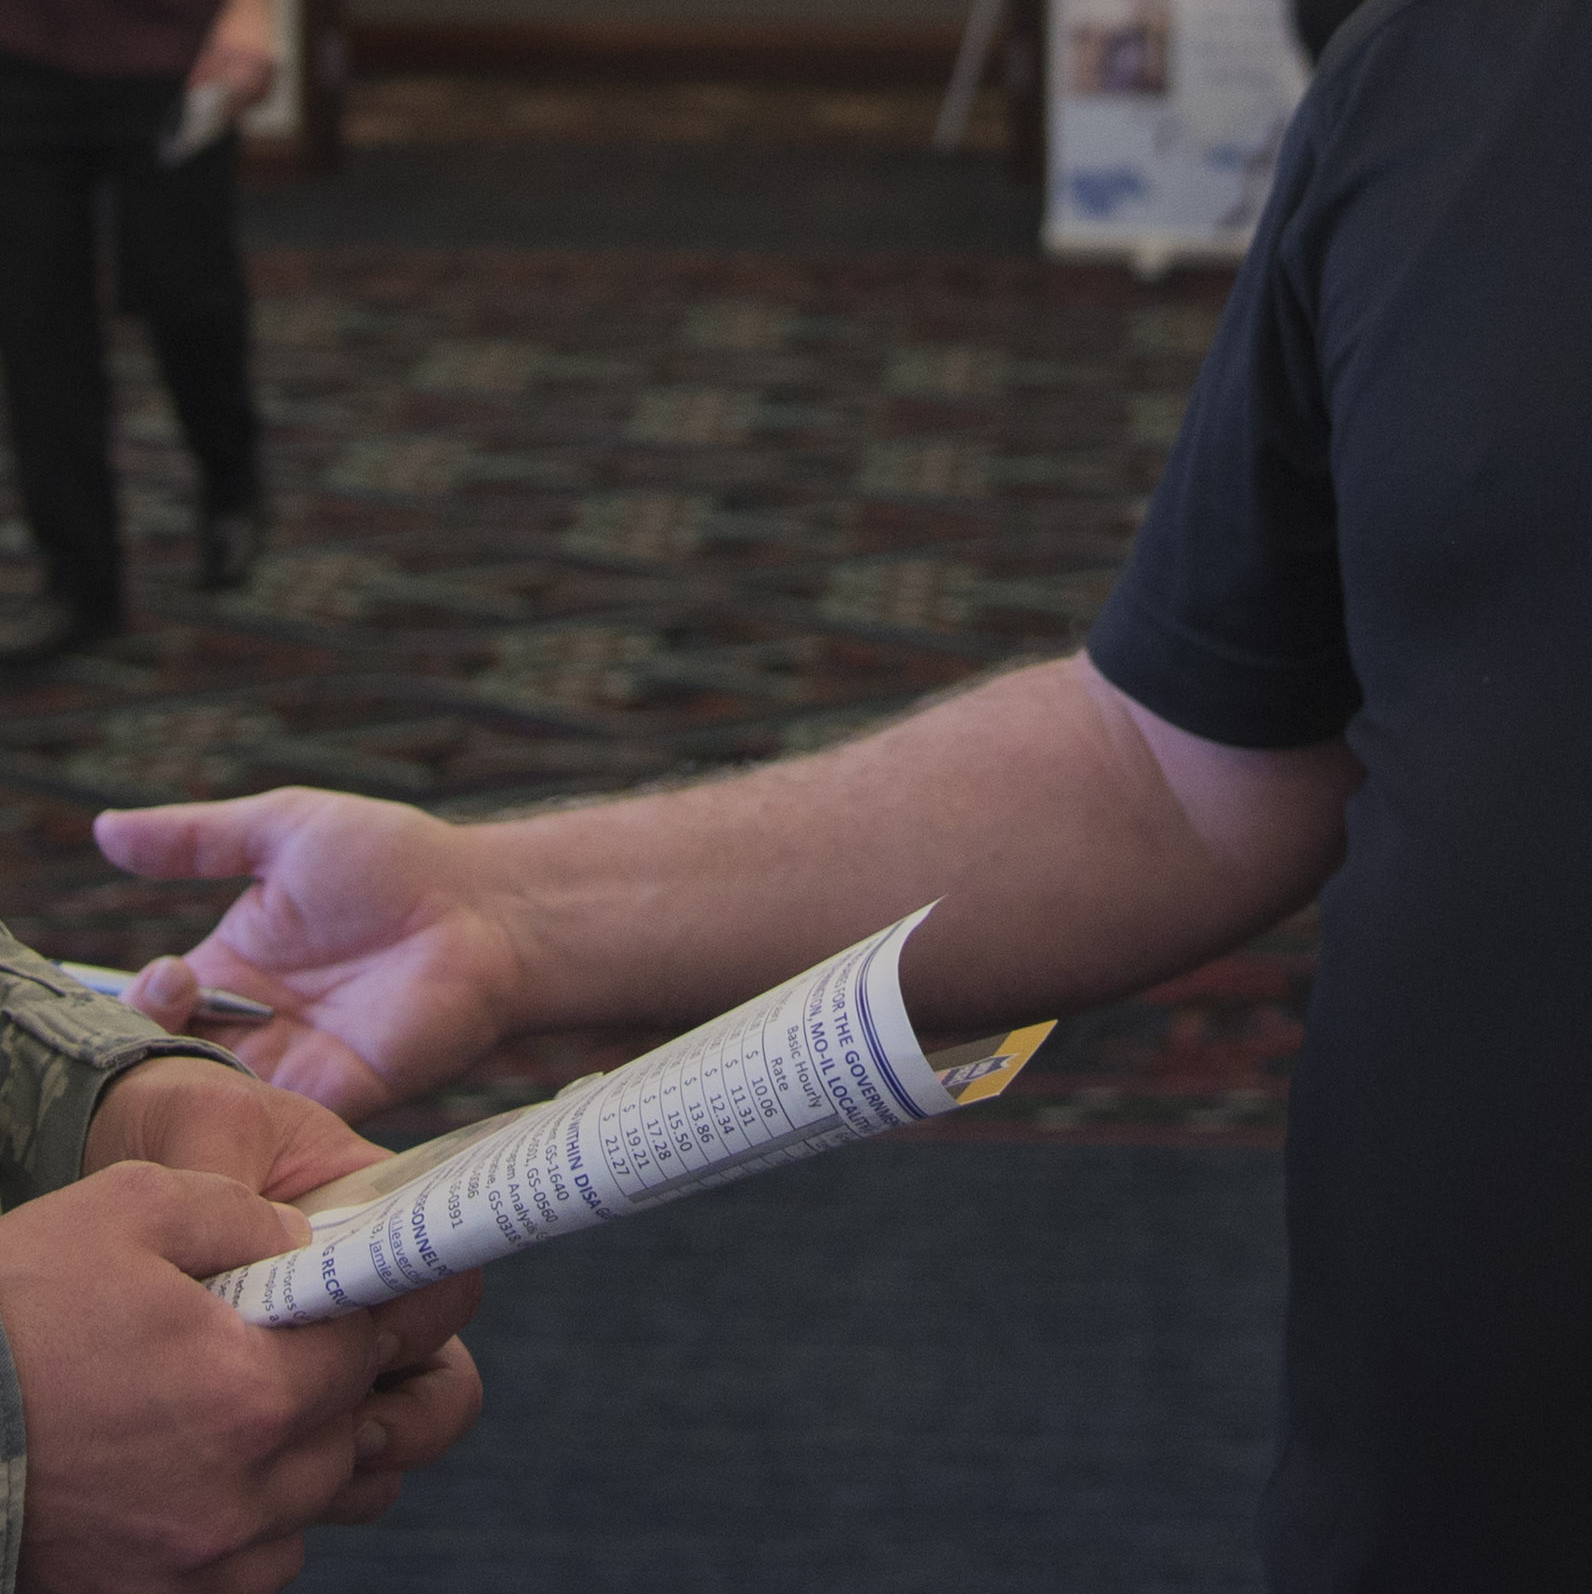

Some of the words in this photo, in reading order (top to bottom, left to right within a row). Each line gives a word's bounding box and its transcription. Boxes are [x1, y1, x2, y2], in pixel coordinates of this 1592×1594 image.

[810, 1021, 836, 1076] MO-IL
[834, 1012, 854, 1048] THE
[771, 1056, 789, 1093] Rate
[787, 1025, 802, 1060] Basic
[795, 1060, 823, 1109] Hourly
[710, 1094, 735, 1135] 12.34
[730, 1085, 756, 1127] 11.31
[752, 1077, 778, 1118] 10.06
[647, 1119, 672, 1161] 17.28
[668, 1111, 693, 1153] 15.50
[689, 1103, 715, 1144] 13.86
[605, 1136, 630, 1177] 21.27
[626, 1128, 650, 1170] 19.21
[545, 1144, 569, 1202] GS-1640
[574, 1173, 602, 1210] DISA
[526, 1167, 559, 1223] GS-0560
